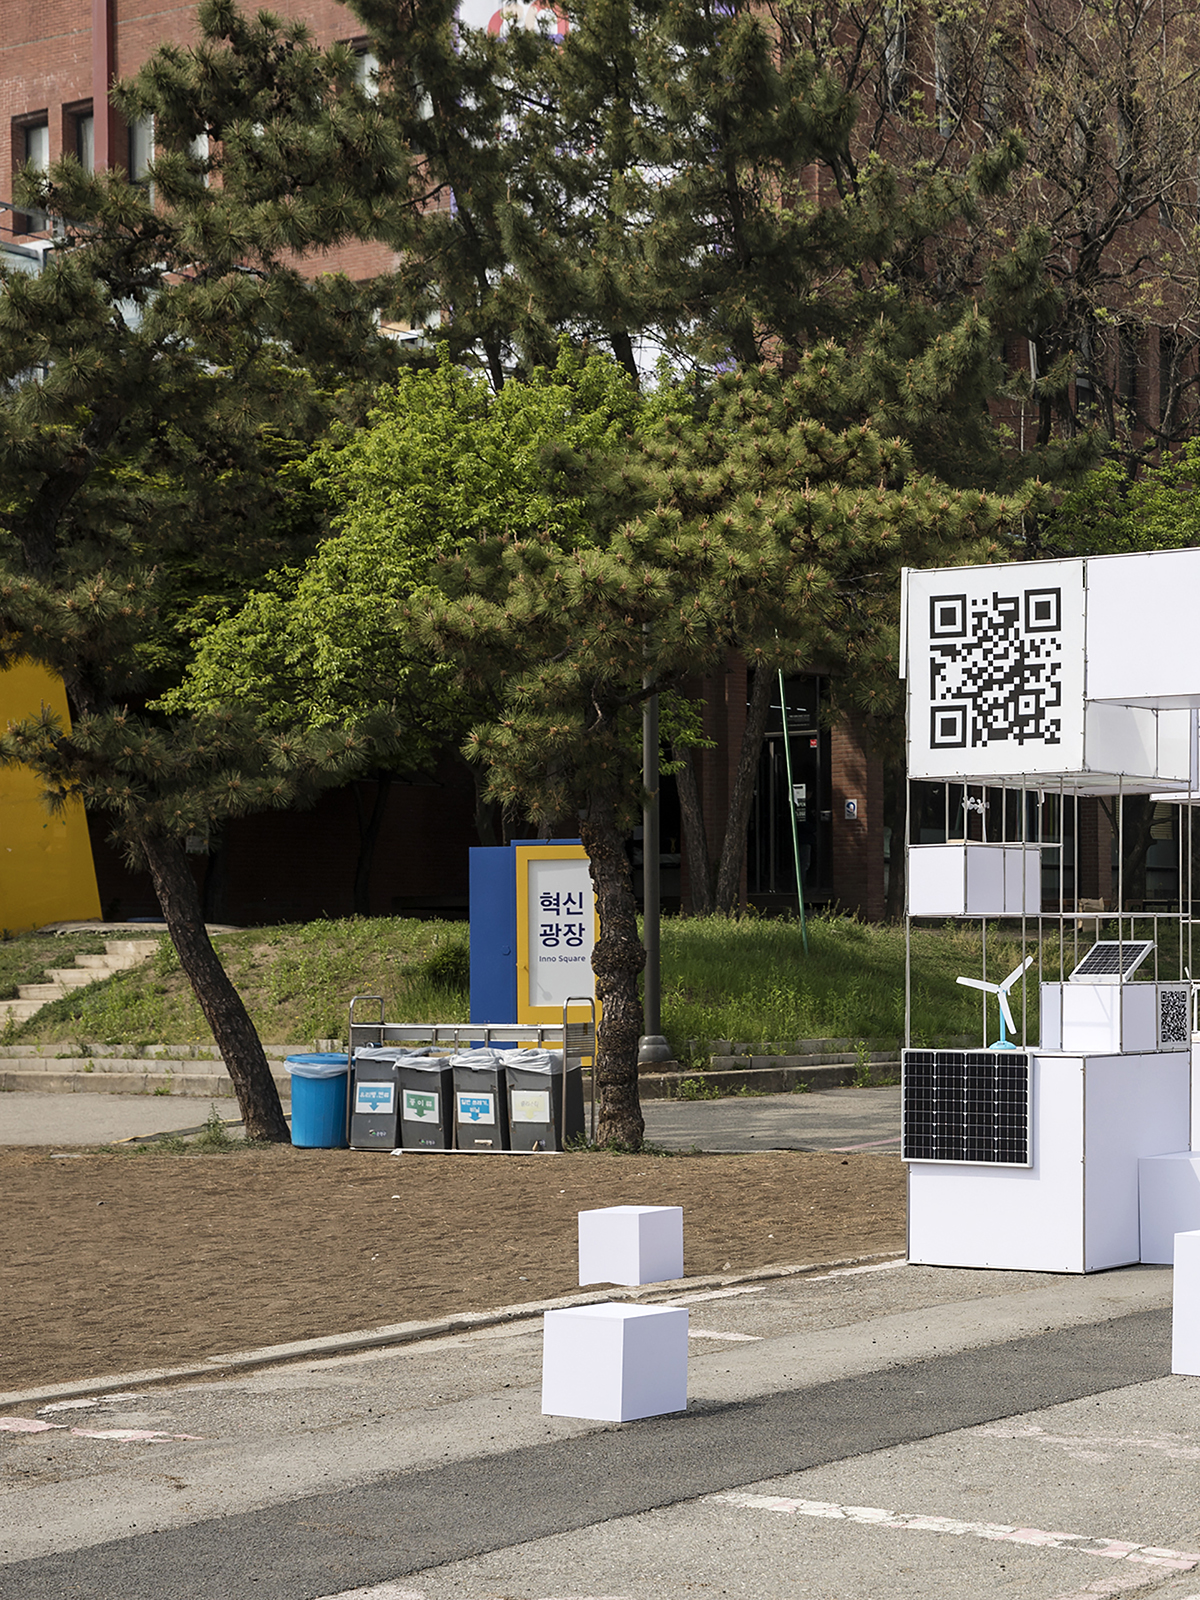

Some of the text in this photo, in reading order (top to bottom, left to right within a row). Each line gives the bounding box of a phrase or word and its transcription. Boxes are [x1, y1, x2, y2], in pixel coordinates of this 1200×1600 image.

[539, 891, 584, 916] 혁신
[539, 922, 586, 948] 광장
[538, 954, 587, 964] Inno Square
